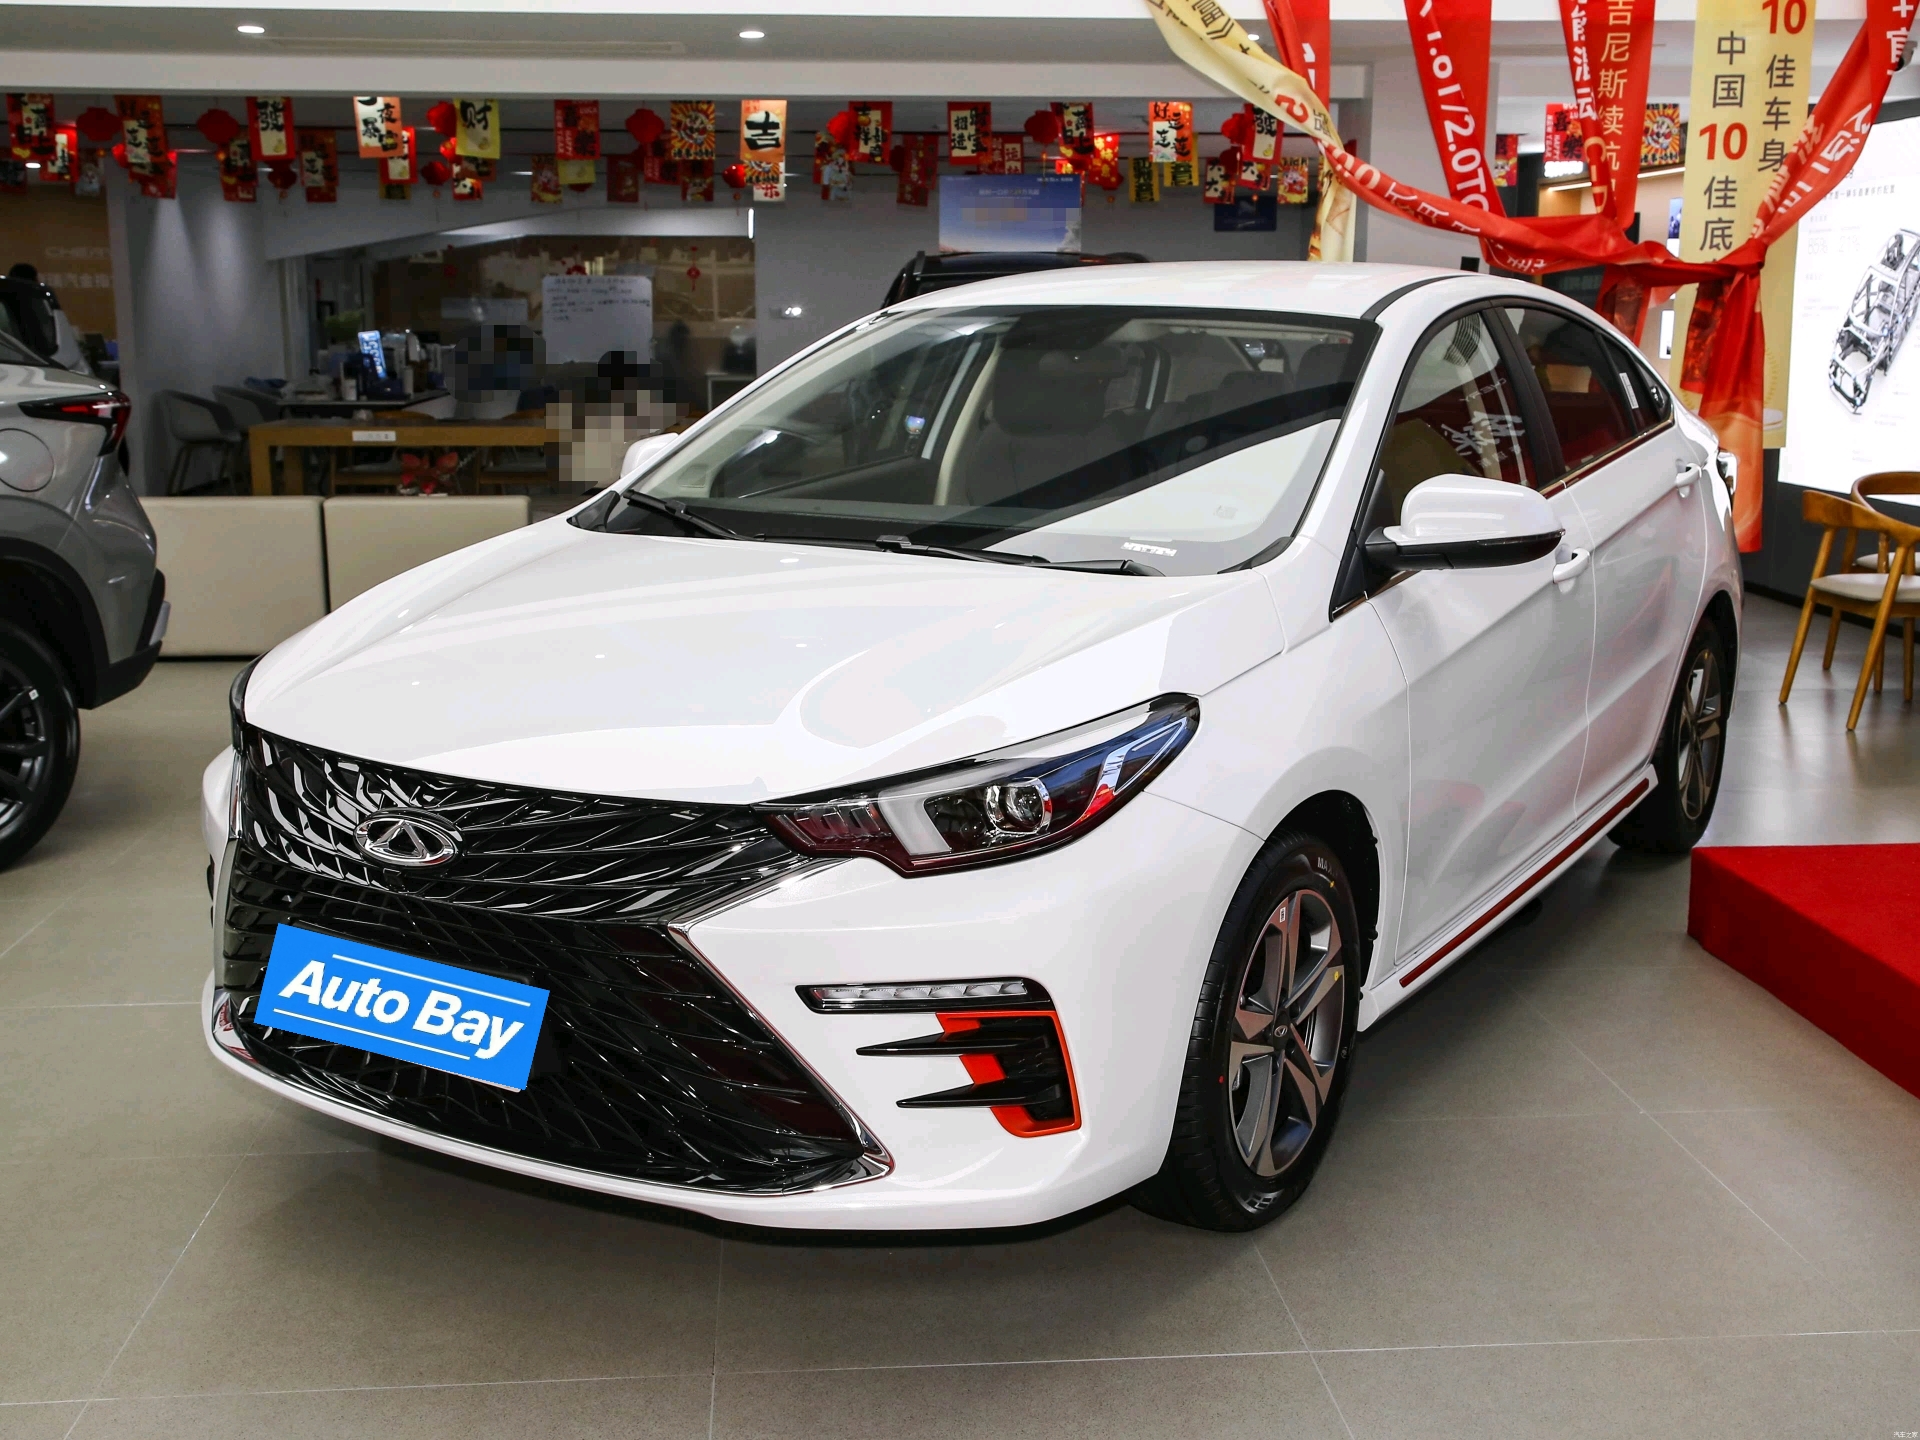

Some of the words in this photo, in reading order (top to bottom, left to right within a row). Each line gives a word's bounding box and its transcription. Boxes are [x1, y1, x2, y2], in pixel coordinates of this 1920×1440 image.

[744, 111, 781, 150] 吉
[1699, 31, 1749, 262] 中国10佳底
